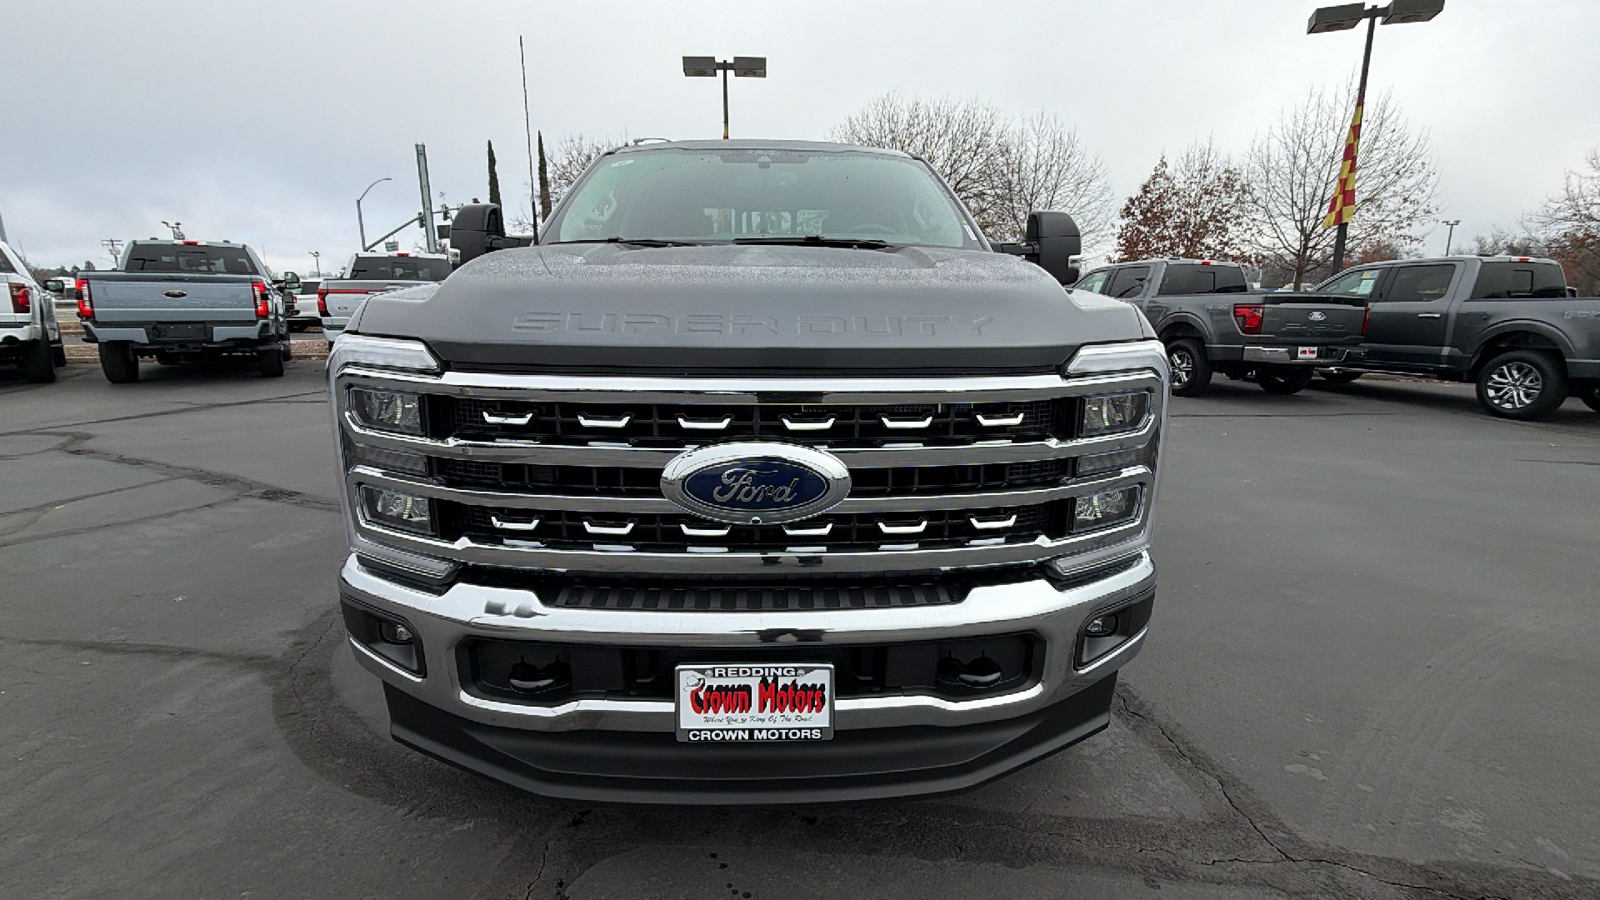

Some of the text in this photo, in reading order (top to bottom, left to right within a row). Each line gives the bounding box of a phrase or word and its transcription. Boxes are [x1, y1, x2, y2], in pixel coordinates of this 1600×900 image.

[511, 312, 994, 336] SUPER DUTY
[712, 467, 800, 503] Ford
[714, 667, 797, 678] REDDING
[690, 677, 826, 715] Crown Motors
[688, 729, 822, 741] CROWN MOTORS
